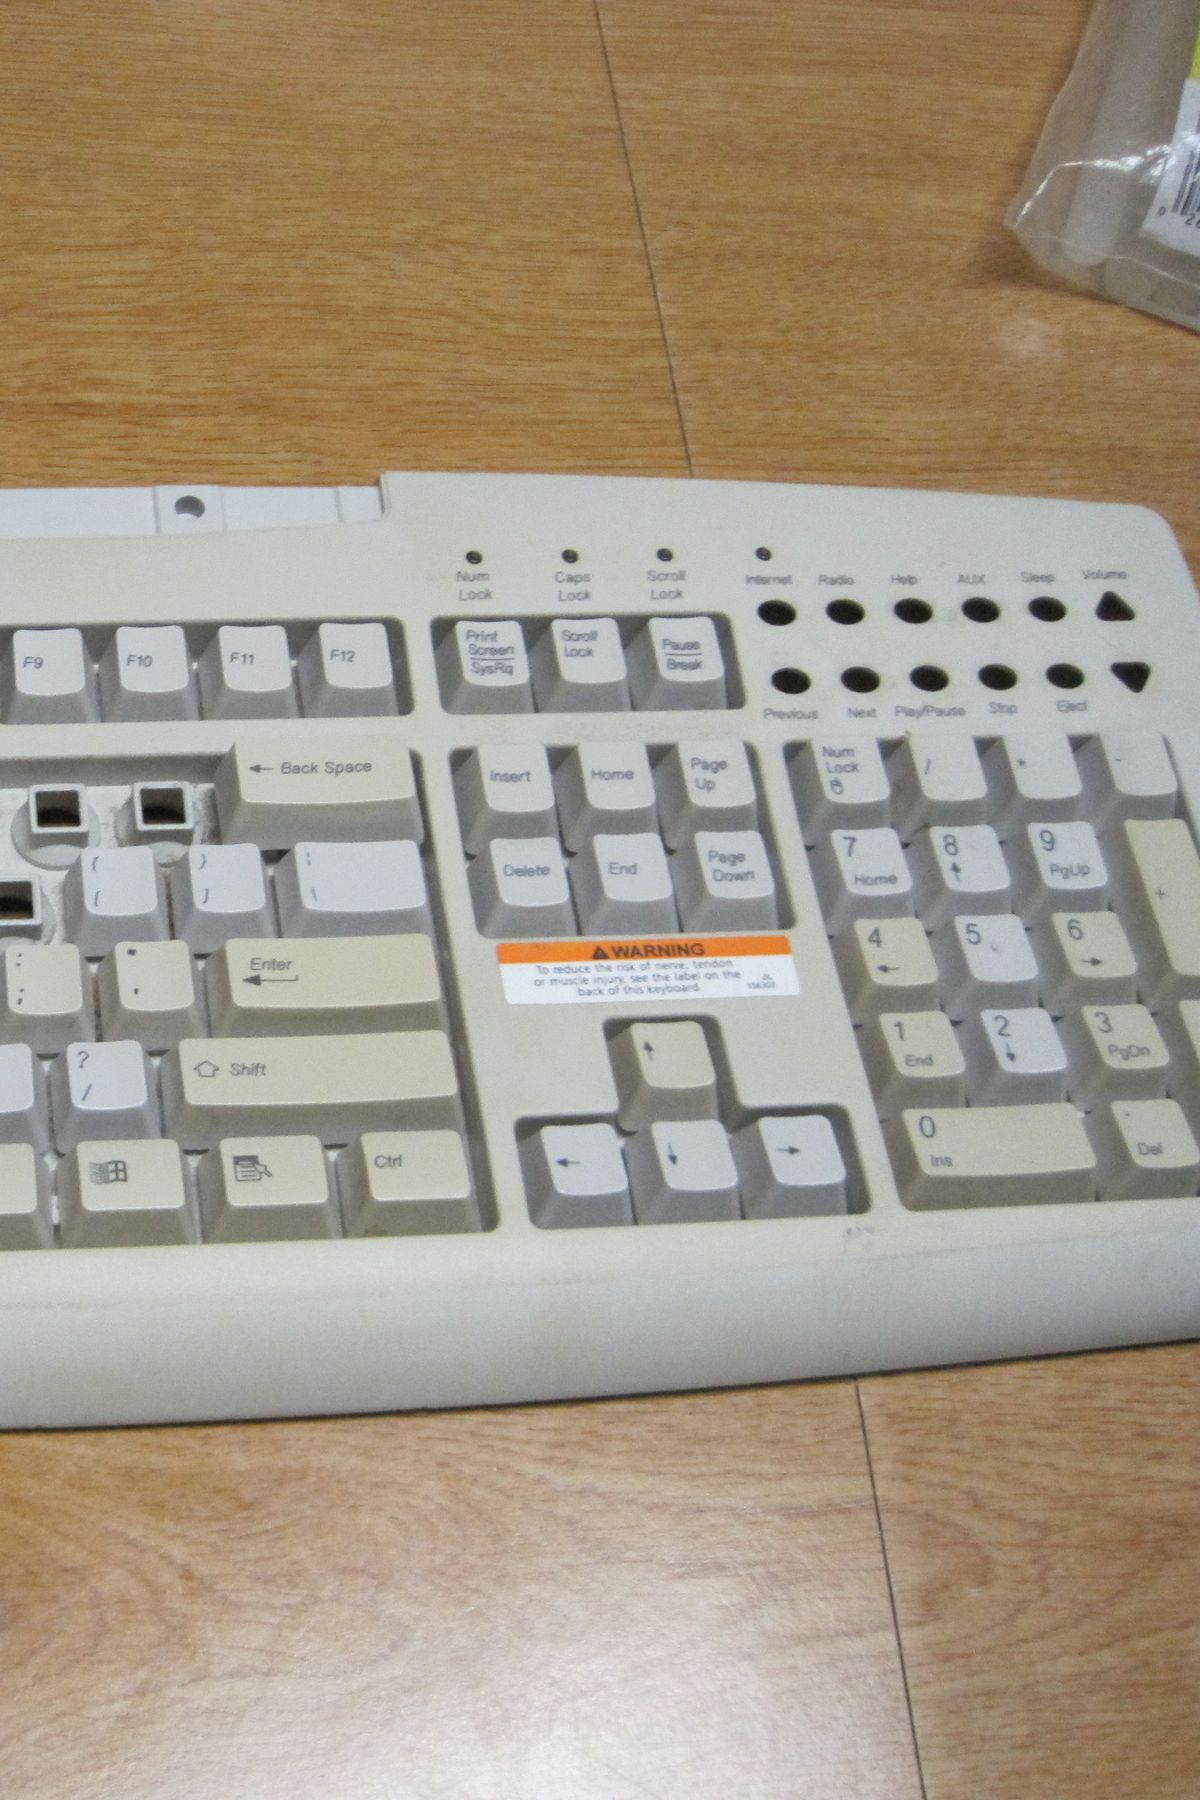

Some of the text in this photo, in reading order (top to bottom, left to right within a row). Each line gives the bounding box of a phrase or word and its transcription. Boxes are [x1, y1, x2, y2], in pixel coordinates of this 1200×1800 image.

[456, 571, 490, 583] Num
[554, 571, 591, 585] Caps
[647, 569, 686, 582] Scroll
[745, 574, 793, 586] Internet
[818, 574, 855, 586] Radio
[891, 574, 918, 586] Help
[957, 574, 986, 585] AUX
[1020, 571, 1055, 584] Sleep
[1082, 569, 1127, 580] Volume
[458, 589, 493, 601] Lock
[558, 589, 592, 602] Lock
[650, 588, 684, 601] Lock
[466, 630, 498, 642] Print
[561, 629, 598, 642] Scroll
[468, 644, 515, 657] Screen
[662, 639, 700, 651] Pause
[230, 652, 255, 665] F11
[330, 649, 355, 663] F12
[564, 646, 594, 658] Lock
[23, 656, 43, 670] F9
[126, 655, 153, 668] F10
[666, 659, 702, 671] Break
[471, 662, 514, 677] SysRq
[848, 707, 877, 718] Next
[895, 704, 966, 719] Play/Pause
[988, 701, 1018, 715] Stop
[1056, 700, 1088, 713] Eject
[763, 707, 819, 720] Previous
[822, 746, 855, 759] Num
[281, 761, 372, 776] Back Space
[691, 757, 728, 773] Page
[826, 761, 860, 774] Lock
[490, 770, 532, 783] Insert
[591, 768, 634, 781] Home
[695, 777, 715, 792] Up
[841, 836, 858, 858] 7
[943, 834, 959, 856] 8
[1039, 830, 1055, 851] 9
[708, 851, 745, 867] Page
[503, 864, 550, 877] Delete
[608, 862, 638, 875] End
[1049, 863, 1091, 880] PgUp
[713, 869, 755, 882] Down
[854, 872, 898, 885] Home
[966, 923, 982, 945] 5
[1067, 919, 1083, 940] 6
[868, 927, 882, 948] 4
[611, 943, 705, 959] WARNING
[250, 957, 293, 971] Enter
[536, 965, 550, 975] To
[553, 964, 592, 974] reduce
[595, 963, 614, 973] the
[617, 962, 636, 971] risk
[640, 961, 651, 971] of
[692, 959, 733, 969] tendon
[550, 976, 589, 986] muscle
[630, 975, 648, 983] see
[652, 972, 671, 982] the
[675, 970, 700, 981] label
[704, 972, 719, 980] on
[722, 969, 741, 979] the
[578, 987, 604, 997] back
[608, 985, 619, 995] of
[623, 985, 644, 995] this
[994, 1015, 1011, 1037] 2
[1095, 1012, 1112, 1033] 3
[893, 1021, 904, 1041] 1
[1108, 1043, 1150, 1060] PgDn
[77, 1050, 90, 1070] ?
[904, 1054, 933, 1067] End
[229, 1062, 267, 1077] Shift
[918, 1115, 936, 1138] 0
[1137, 1142, 1164, 1156] Del
[374, 1153, 402, 1169] Ctrl
[930, 1154, 953, 1167] Ins
